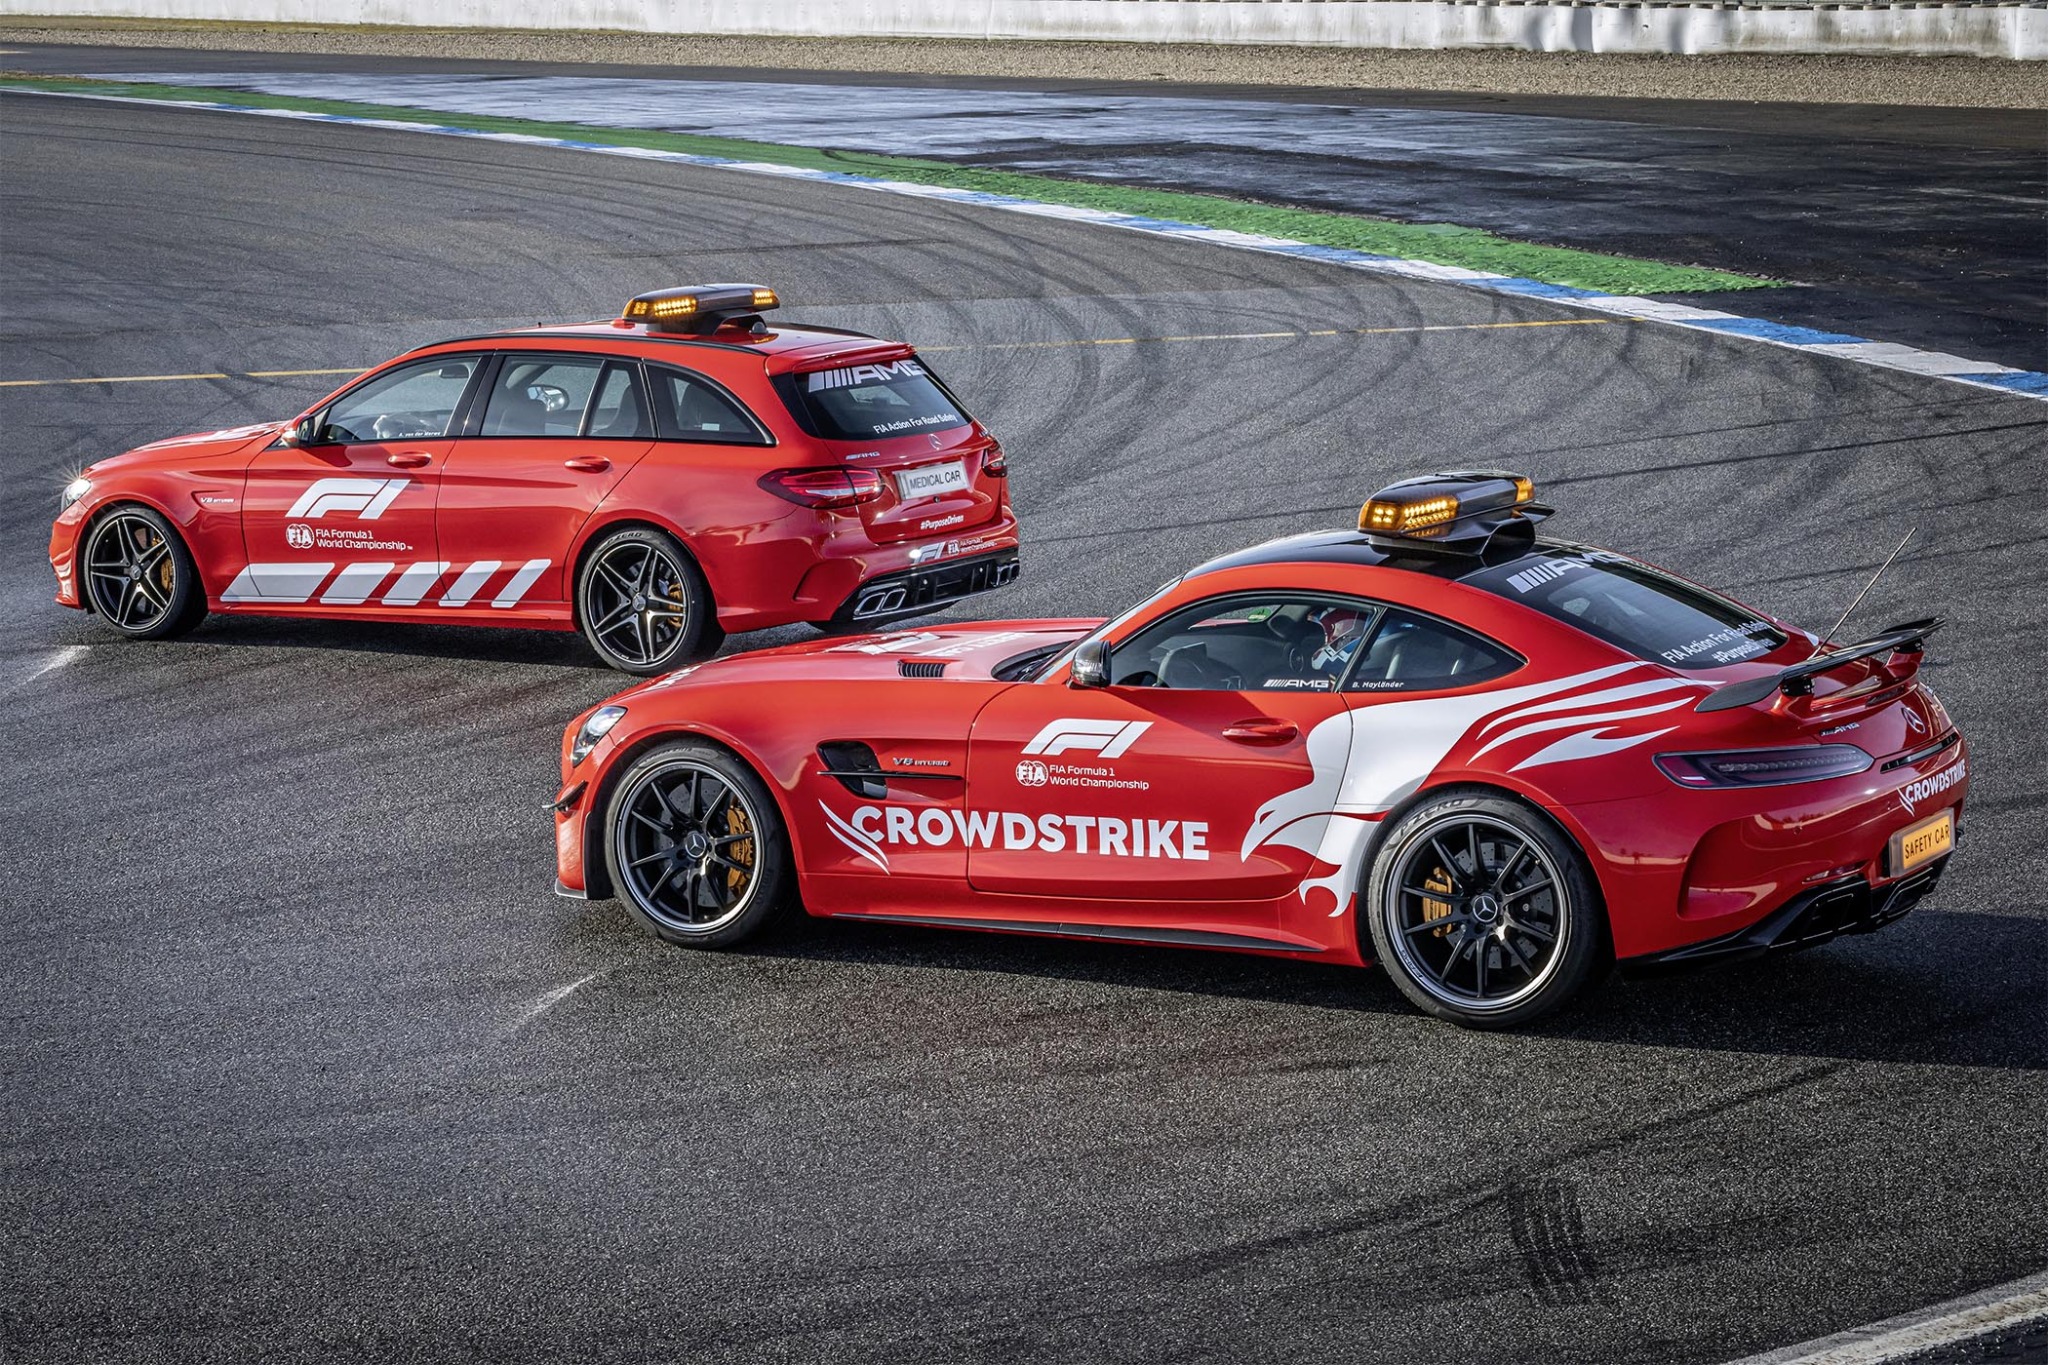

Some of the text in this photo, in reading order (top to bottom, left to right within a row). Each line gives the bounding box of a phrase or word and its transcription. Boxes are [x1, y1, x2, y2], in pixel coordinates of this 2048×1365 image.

[873, 424, 889, 434] FIA
[887, 420, 911, 431] Action
[909, 417, 924, 427] For
[921, 414, 940, 425] Road
[909, 470, 962, 489] MEDICAL CAR
[315, 528, 374, 539] FIA Formula 1
[316, 538, 343, 548] World
[343, 539, 406, 550] Championship
[1661, 649, 1687, 663] FIA
[1680, 638, 1715, 655] Action
[1708, 629, 1733, 646] For
[1286, 680, 1329, 688] AMG
[1049, 764, 1116, 777] FIA Formula 1
[1049, 776, 1150, 790] World Championship
[1905, 759, 1966, 803] CROWDSTRIKE
[851, 805, 1211, 861] CROWDSTRIKE
[1904, 824, 1950, 860] SAFETY CAR
